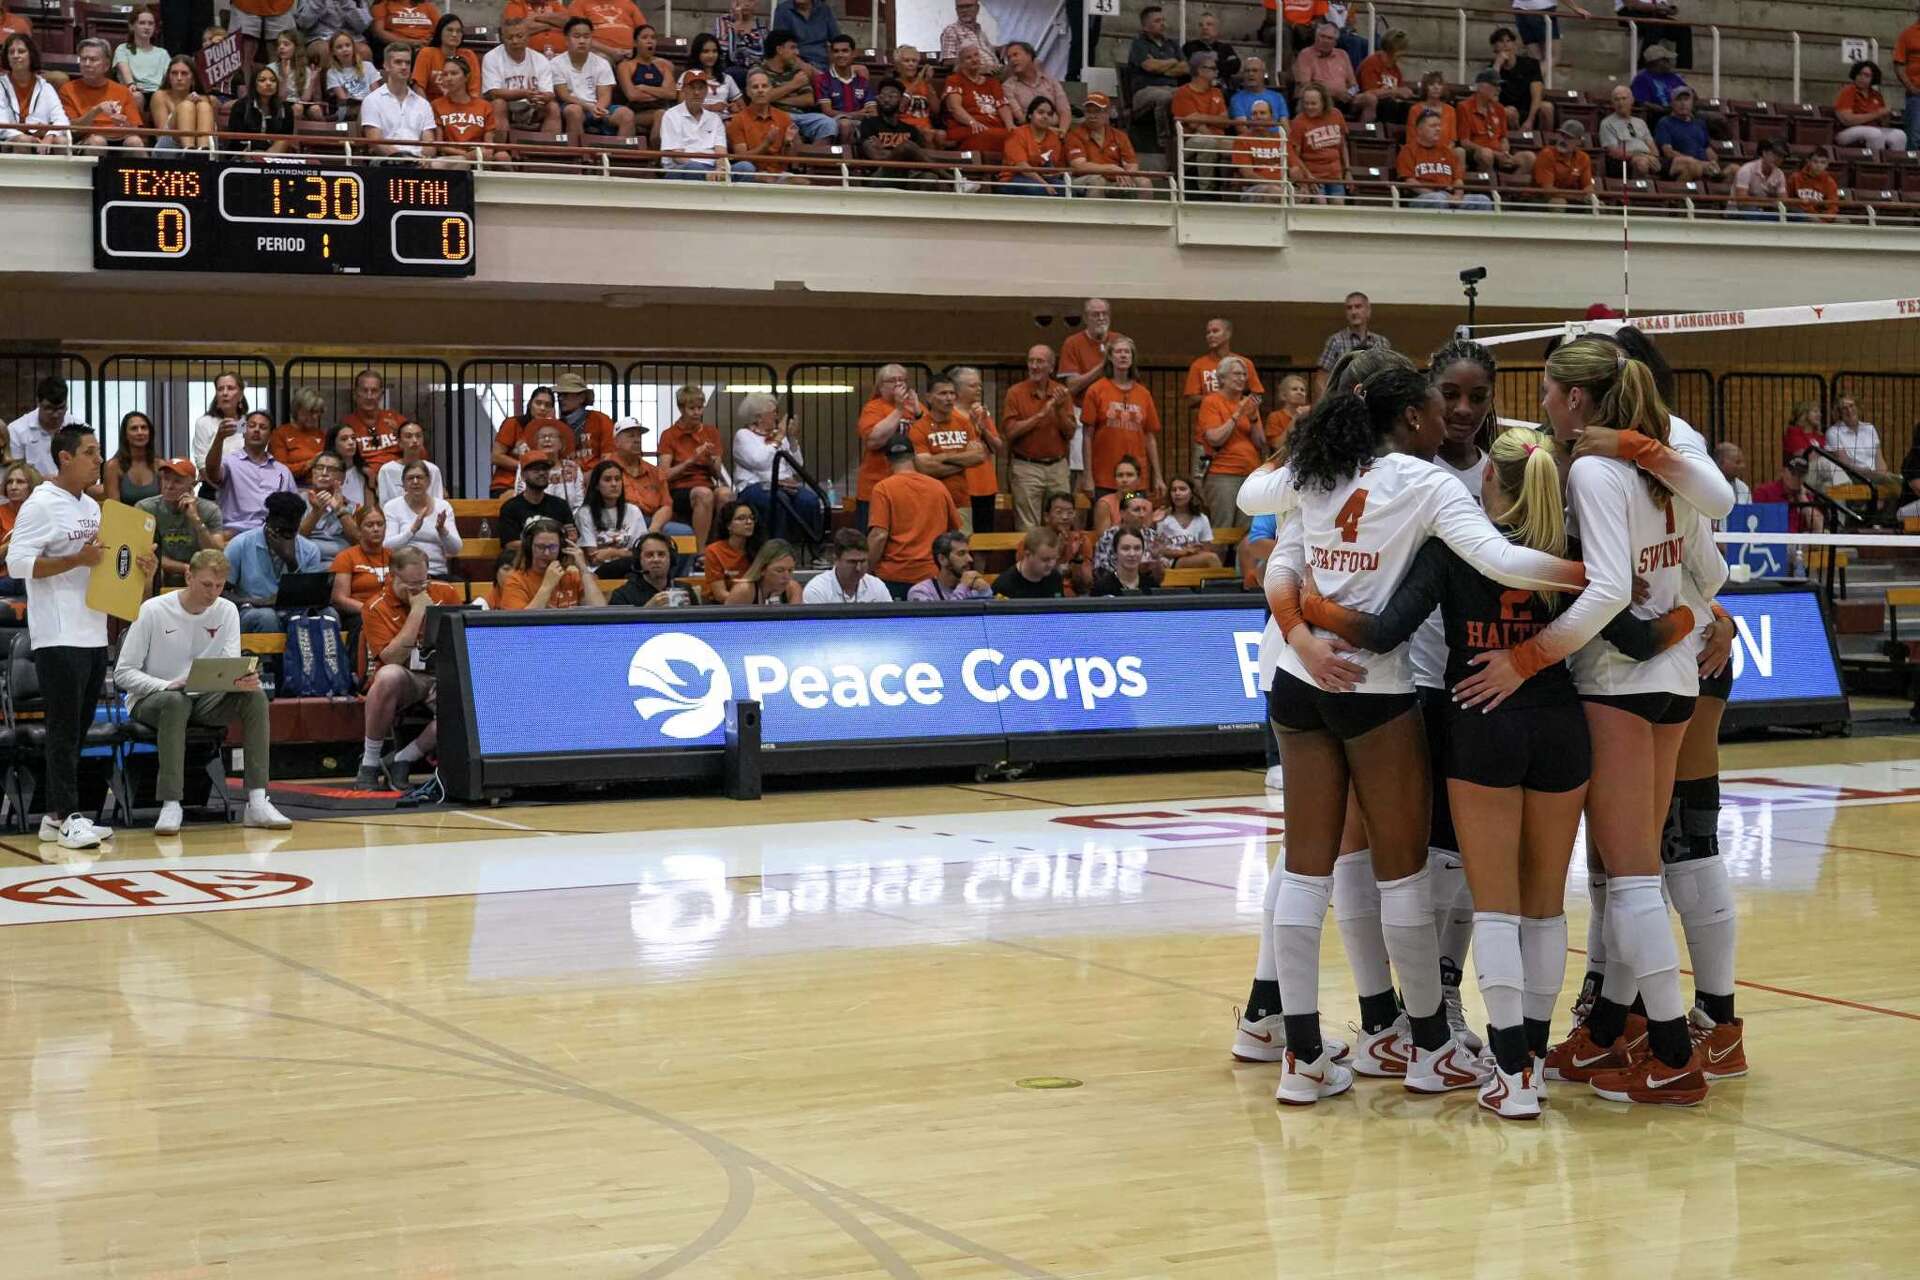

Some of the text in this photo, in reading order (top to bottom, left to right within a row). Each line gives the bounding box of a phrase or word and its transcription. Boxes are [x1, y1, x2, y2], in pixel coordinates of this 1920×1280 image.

[204, 34, 236, 67] POINT
[440, 112, 485, 127] TEXAS
[1250, 147, 1281, 159] TEXA
[118, 169, 200, 197] TEXAS
[263, 168, 318, 176] DAKTRONICS
[272, 176, 359, 220] 1:30
[389, 178, 449, 206] UTAH
[158, 208, 184, 252] 0
[442, 217, 466, 260] 0
[257, 233, 330, 259] PERIOD 1
[1630, 311, 1745, 330] EXAS LONGHORNS
[356, 433, 399, 451] TEAS
[77, 519, 99, 529] TEXA
[1334, 487, 1370, 543] 4
[1637, 536, 1684, 574] SWIN
[743, 648, 1148, 710] Peace Corps
